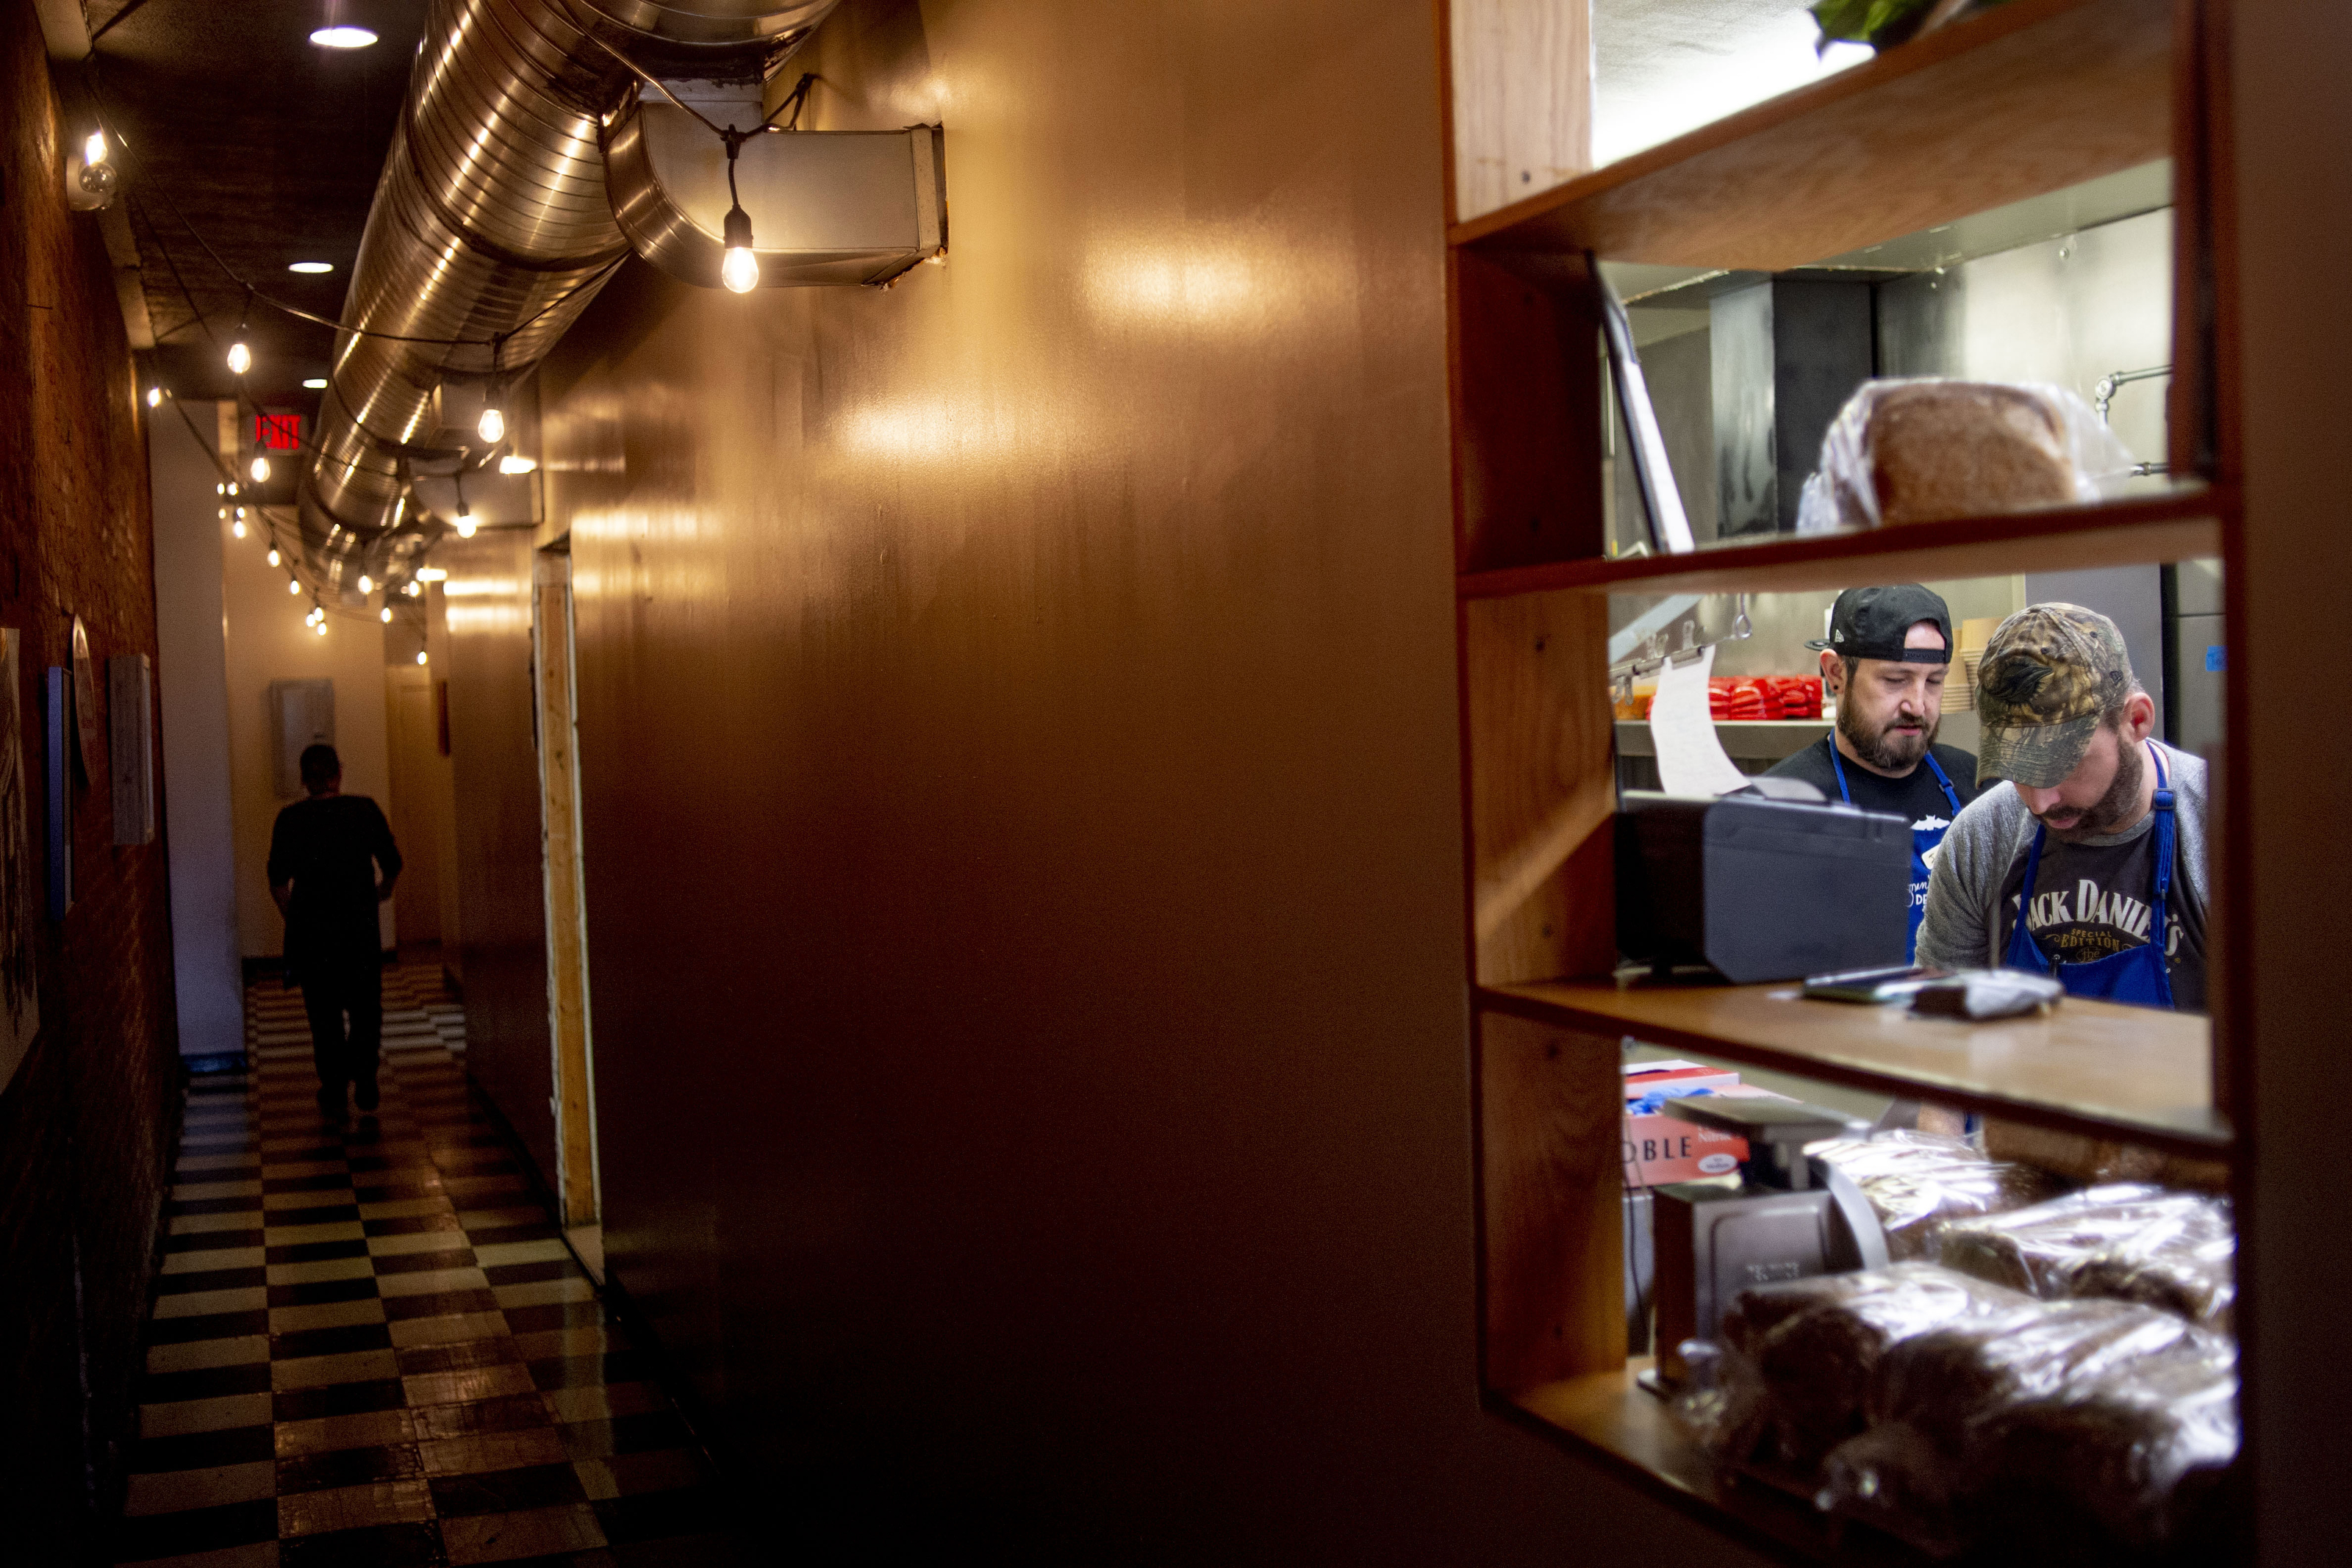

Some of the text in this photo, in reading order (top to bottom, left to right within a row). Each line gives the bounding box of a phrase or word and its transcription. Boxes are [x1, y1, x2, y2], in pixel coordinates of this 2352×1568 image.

[256, 414, 301, 450] EXIT
[2076, 879, 2184, 957] DANIE'S
[2060, 933, 2120, 952] EDITION
[2071, 928, 2112, 938] SPECIAL
